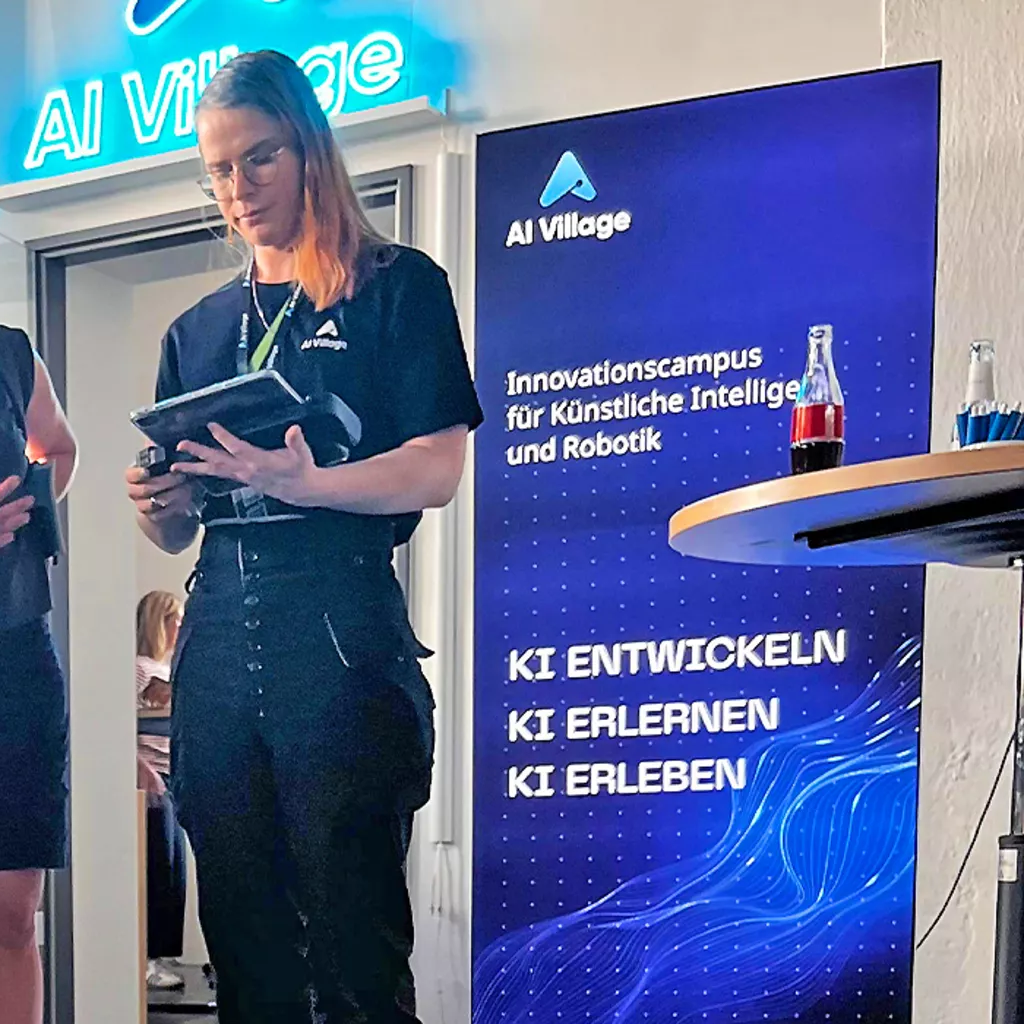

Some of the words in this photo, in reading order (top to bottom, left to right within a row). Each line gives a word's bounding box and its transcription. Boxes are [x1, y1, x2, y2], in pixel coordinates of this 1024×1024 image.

[23, 77, 104, 170] AI
[505, 219, 534, 248] AI
[538, 210, 632, 242] Village
[300, 339, 313, 350] AI
[313, 338, 347, 351] Village
[506, 347, 764, 396] Innovationscampus
[506, 402, 544, 432] für
[551, 388, 684, 427] Künstliche
[690, 377, 801, 412] Intellige
[506, 435, 557, 466] und
[563, 427, 663, 461] Robotik
[508, 647, 556, 682] KI
[567, 628, 848, 679] ENTWICKELN
[508, 708, 555, 742] KI
[566, 697, 780, 741] ERLERNEN
[507, 765, 555, 798] KI
[566, 757, 747, 796] ERLEBEN
